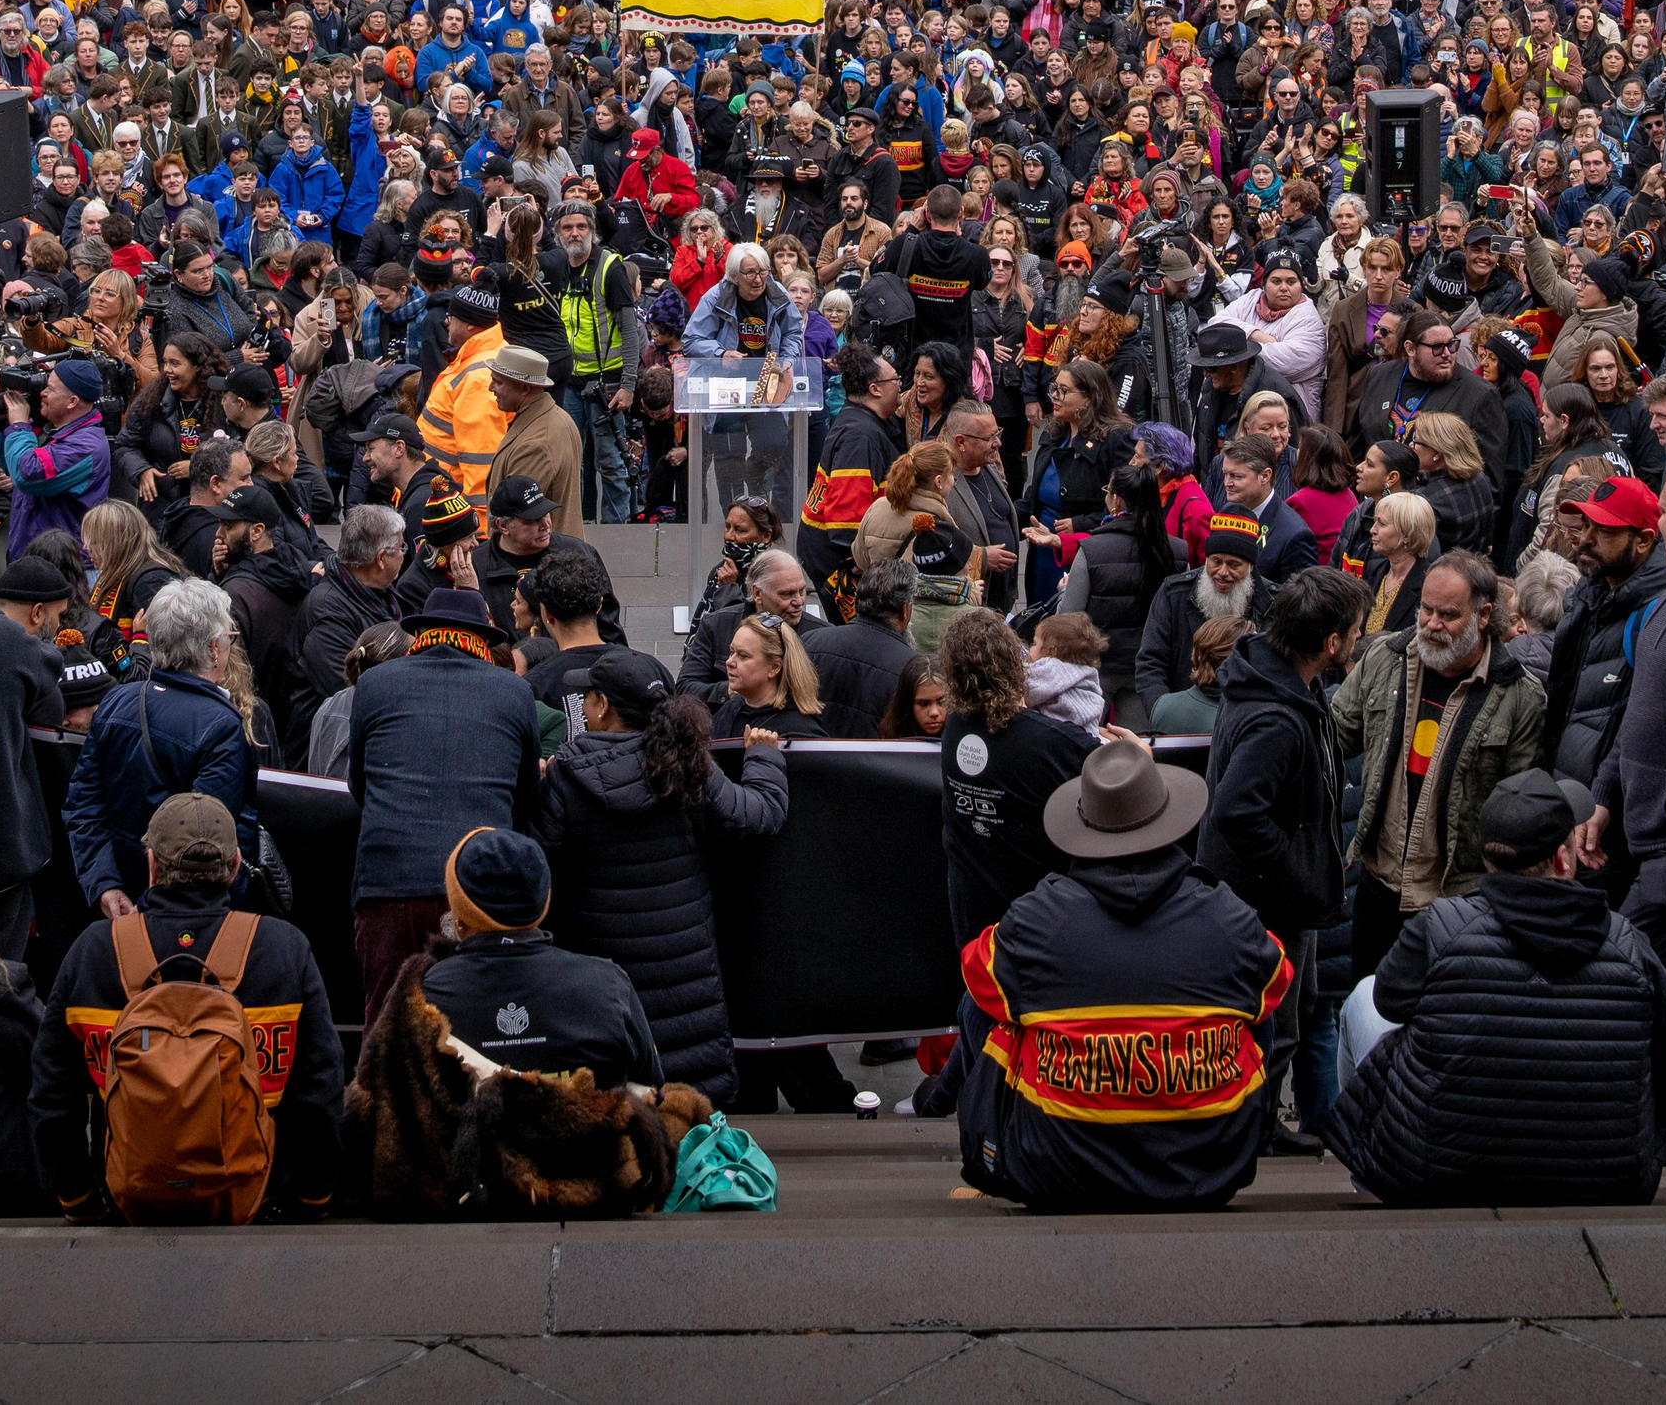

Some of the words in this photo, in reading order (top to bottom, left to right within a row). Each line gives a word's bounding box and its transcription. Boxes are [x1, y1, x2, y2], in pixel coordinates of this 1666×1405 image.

[914, 276, 964, 289] SOVEREIGNTY
[1117, 374, 1134, 412] TRAFFIC
[252, 1024, 291, 1076] BE
[1036, 1030, 1153, 1094] ALWAYS
